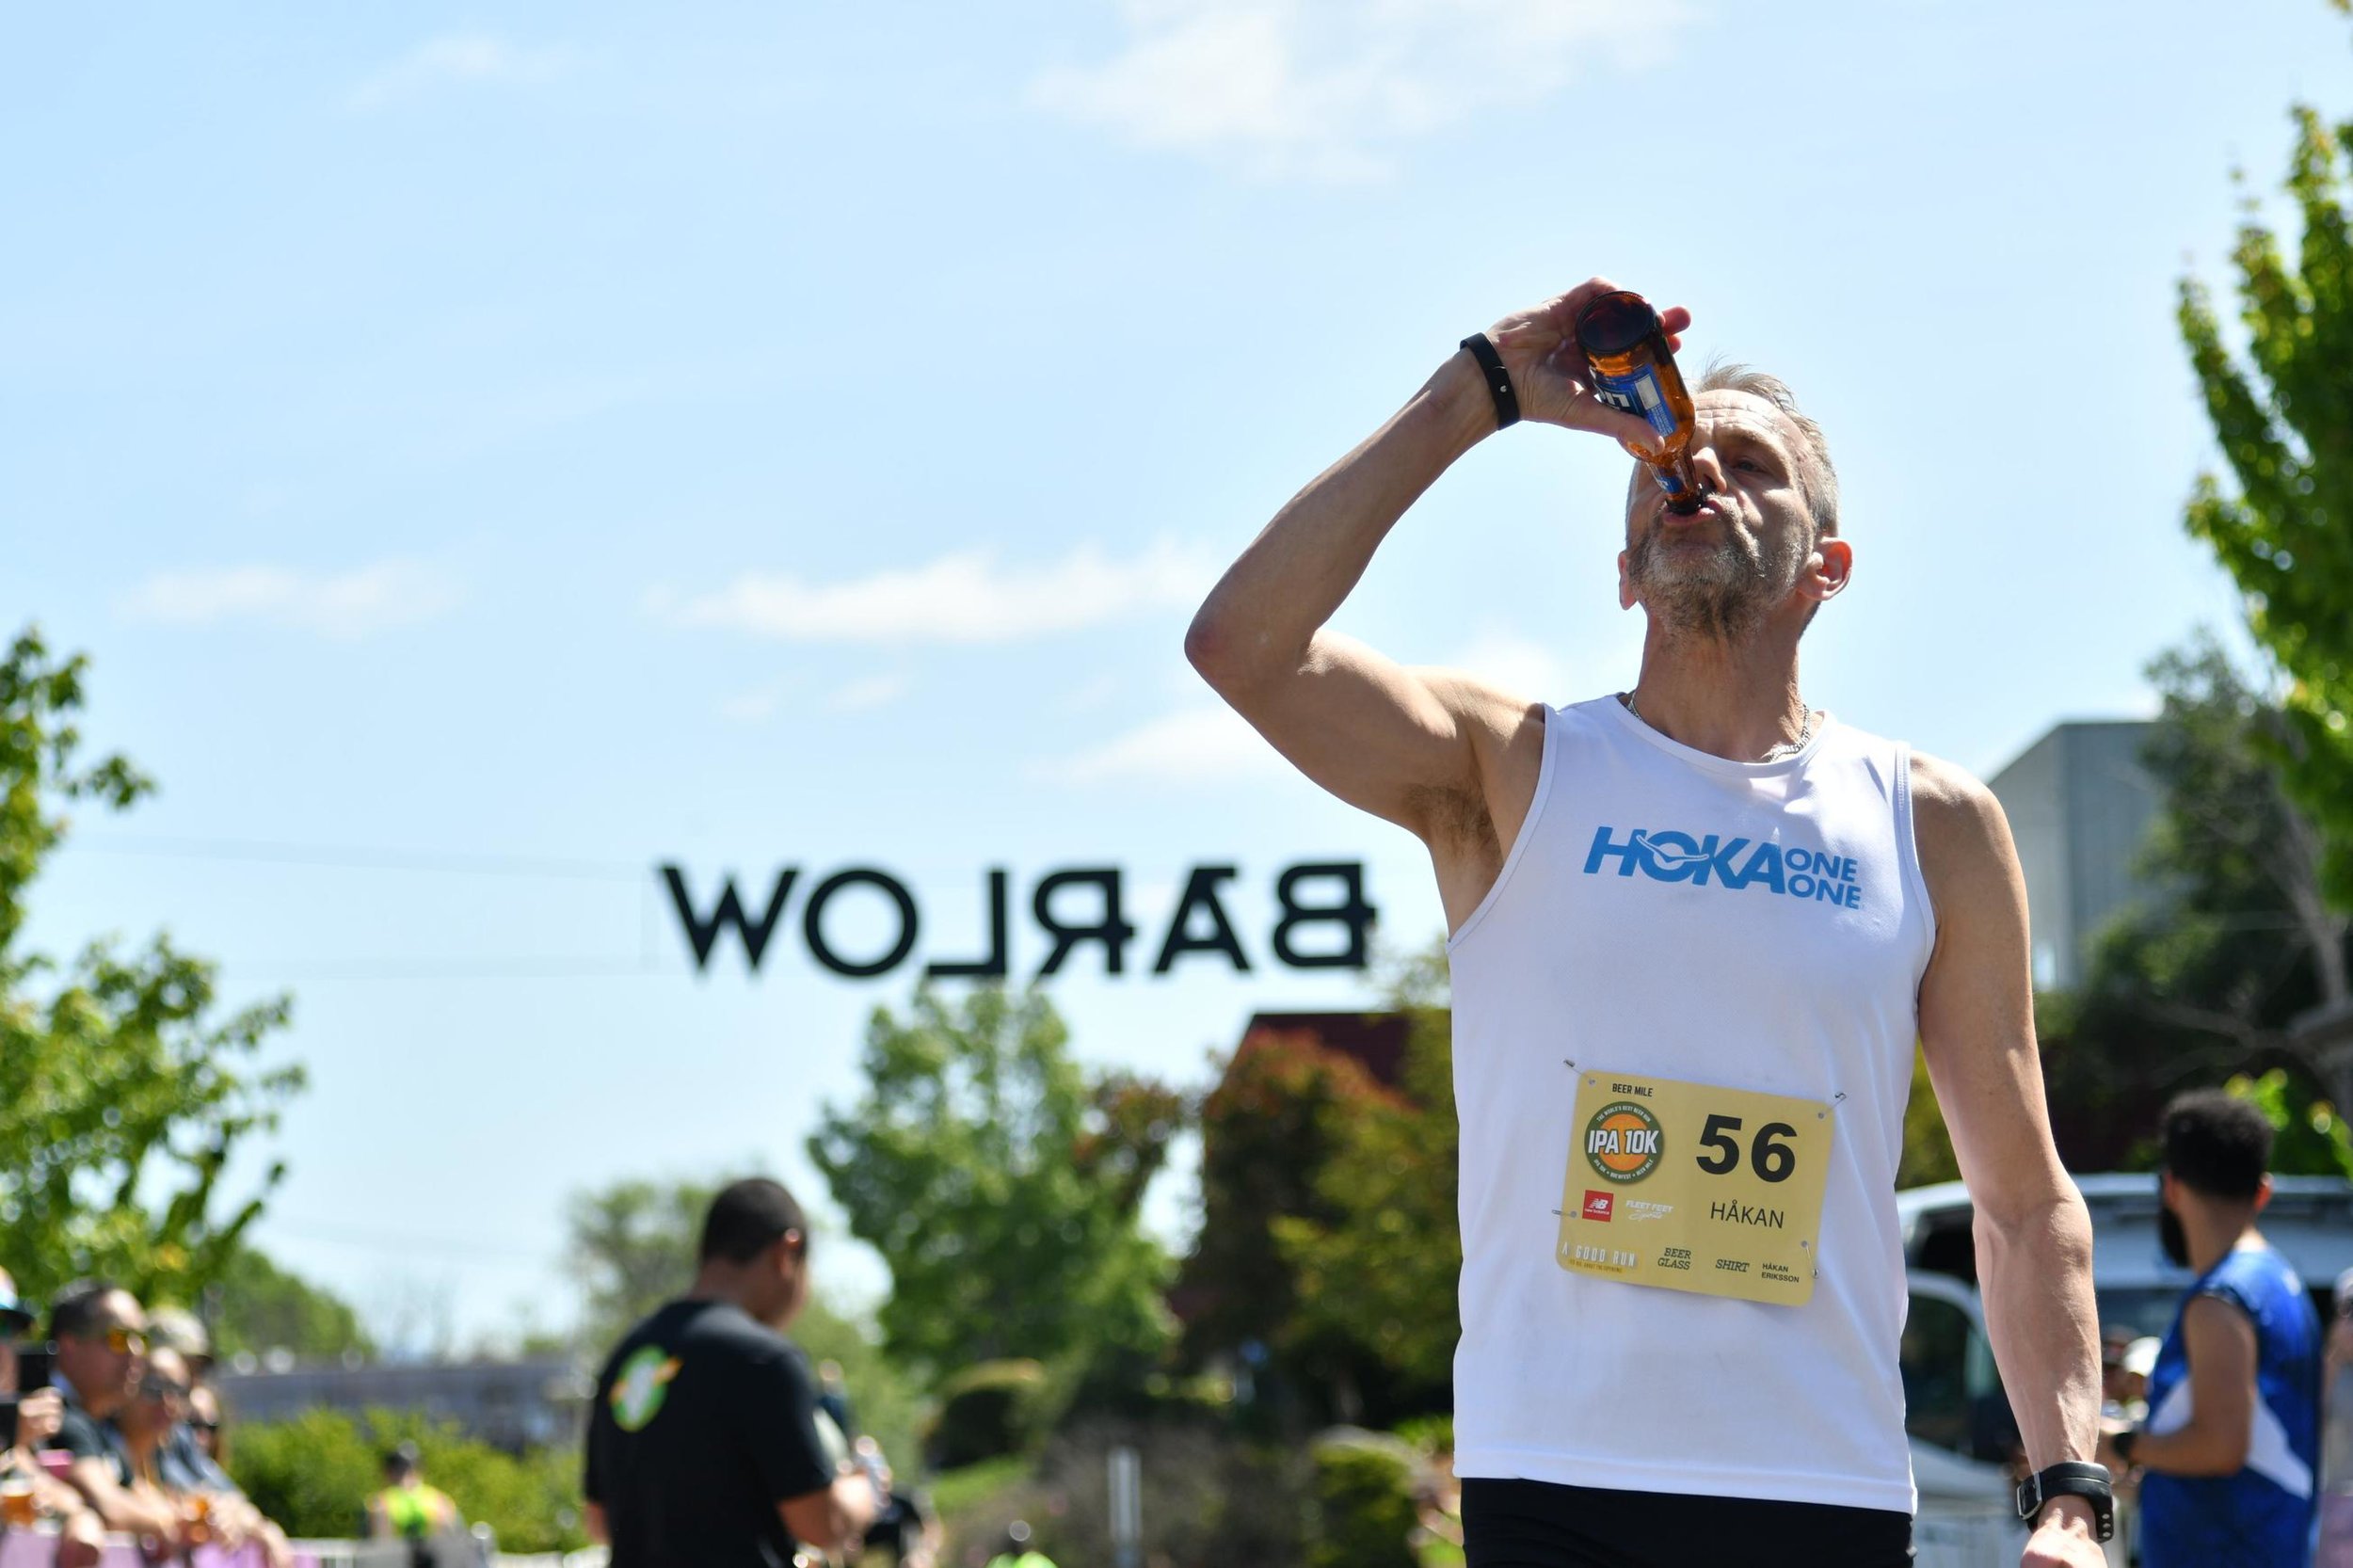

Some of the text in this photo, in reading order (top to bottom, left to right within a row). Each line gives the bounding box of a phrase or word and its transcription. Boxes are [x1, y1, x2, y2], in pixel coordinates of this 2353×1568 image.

[1583, 826, 1785, 894] HOKA
[1785, 848, 1859, 884] ONE
[1788, 874, 1863, 909] ONE
[1612, 1083, 1653, 1097] BEER MILE
[1588, 1129, 1659, 1154] IPA 10K
[1695, 1113, 1798, 1184] 56
[1625, 1200, 1673, 1213] FLEET FEET
[1710, 1199, 1785, 1229] HÅKAN
[1562, 1241, 1568, 1256] A
[1576, 1244, 1606, 1263] GOOD
[1612, 1250, 1635, 1267] RUN
[1664, 1247, 1691, 1259] BEER
[1657, 1257, 1690, 1271] GLASS
[1715, 1258, 1750, 1272] SHIRT
[1762, 1262, 1788, 1272] HÅKAN
[1761, 1272, 1800, 1283] ERIKSSON
